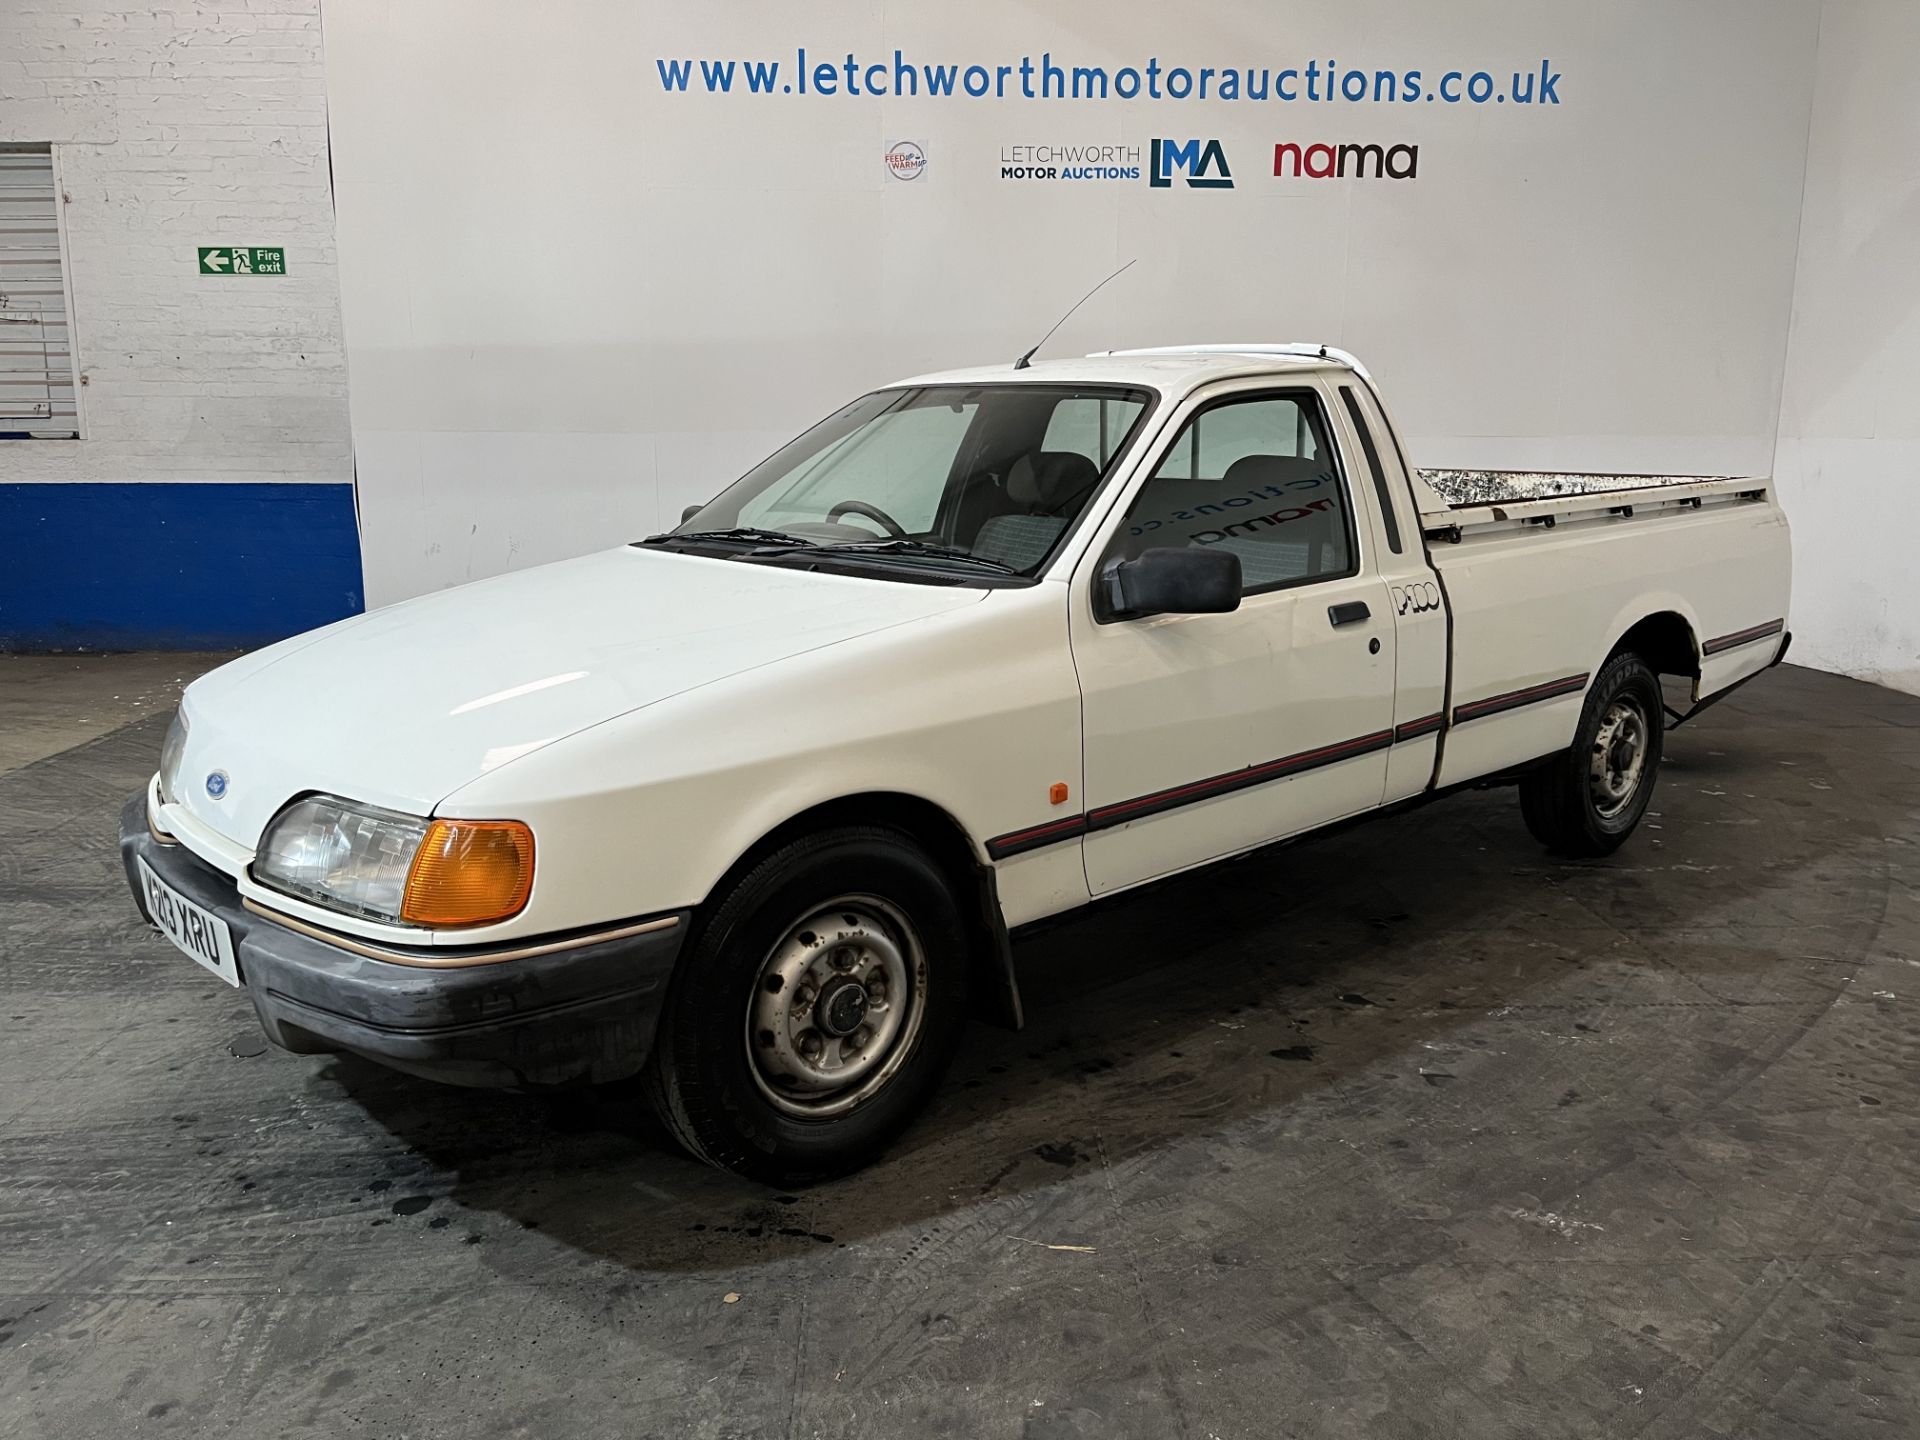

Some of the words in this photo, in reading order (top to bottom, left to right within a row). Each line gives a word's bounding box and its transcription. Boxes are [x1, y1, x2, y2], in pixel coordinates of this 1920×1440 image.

[656, 48, 1561, 104] www.letchworthmotorauctions.co.uk
[885, 154, 905, 163] FEED
[1001, 146, 1140, 163] LETCHWORTH
[1274, 142, 1418, 180] nama
[891, 160, 917, 170] WARM
[1150, 138, 1235, 188] LMA
[1001, 167, 1057, 180] MOTOR
[1061, 167, 1141, 180] AUCTIONS
[256, 249, 281, 261] Fire
[258, 261, 282, 273] exit
[175, 899, 220, 966] XRU
